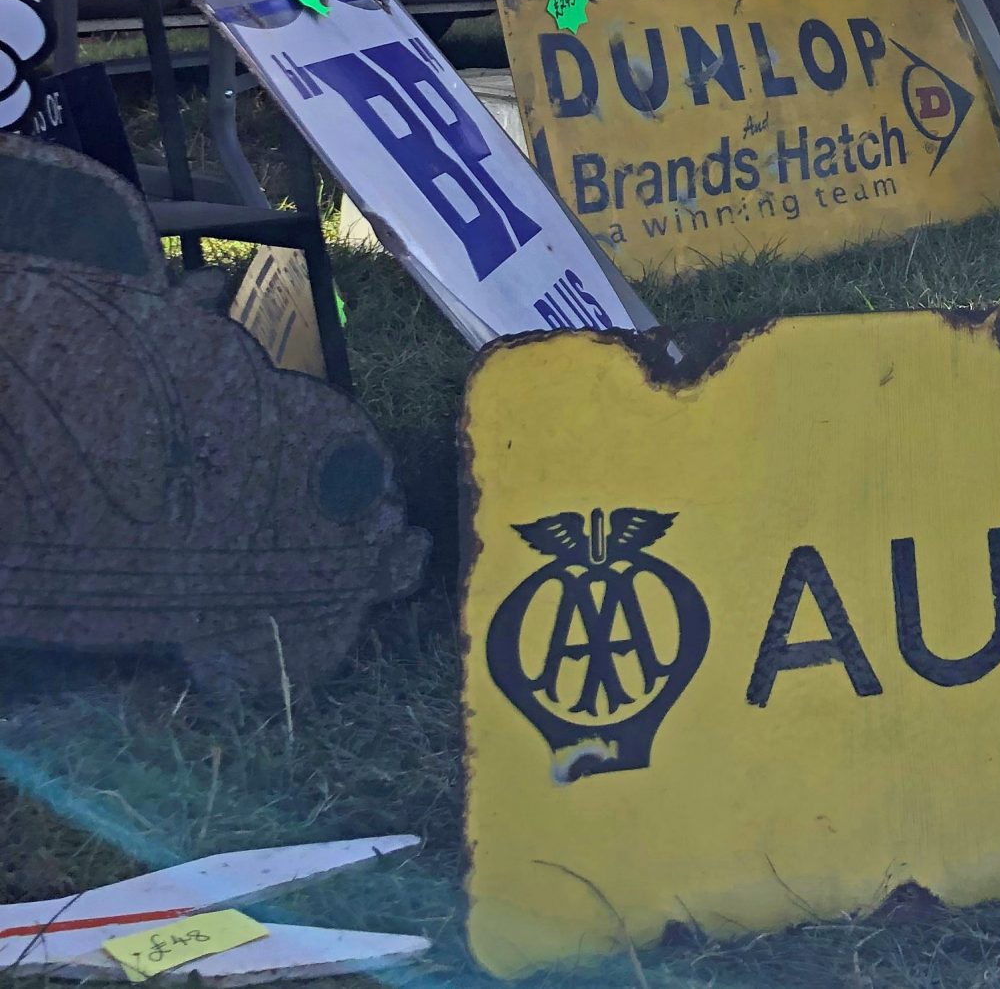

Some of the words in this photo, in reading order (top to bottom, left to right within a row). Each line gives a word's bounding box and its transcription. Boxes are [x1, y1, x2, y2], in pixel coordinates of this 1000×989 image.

[539, 17, 887, 119] DUNLOP
[743, 111, 769, 139] And
[914, 86, 952, 119] D
[574, 136, 759, 215] Brands
[776, 116, 907, 184] Hatch
[609, 221, 626, 244] a
[643, 190, 800, 239] winning
[816, 176, 897, 208] team
[147, 929, 211, 963] £48
